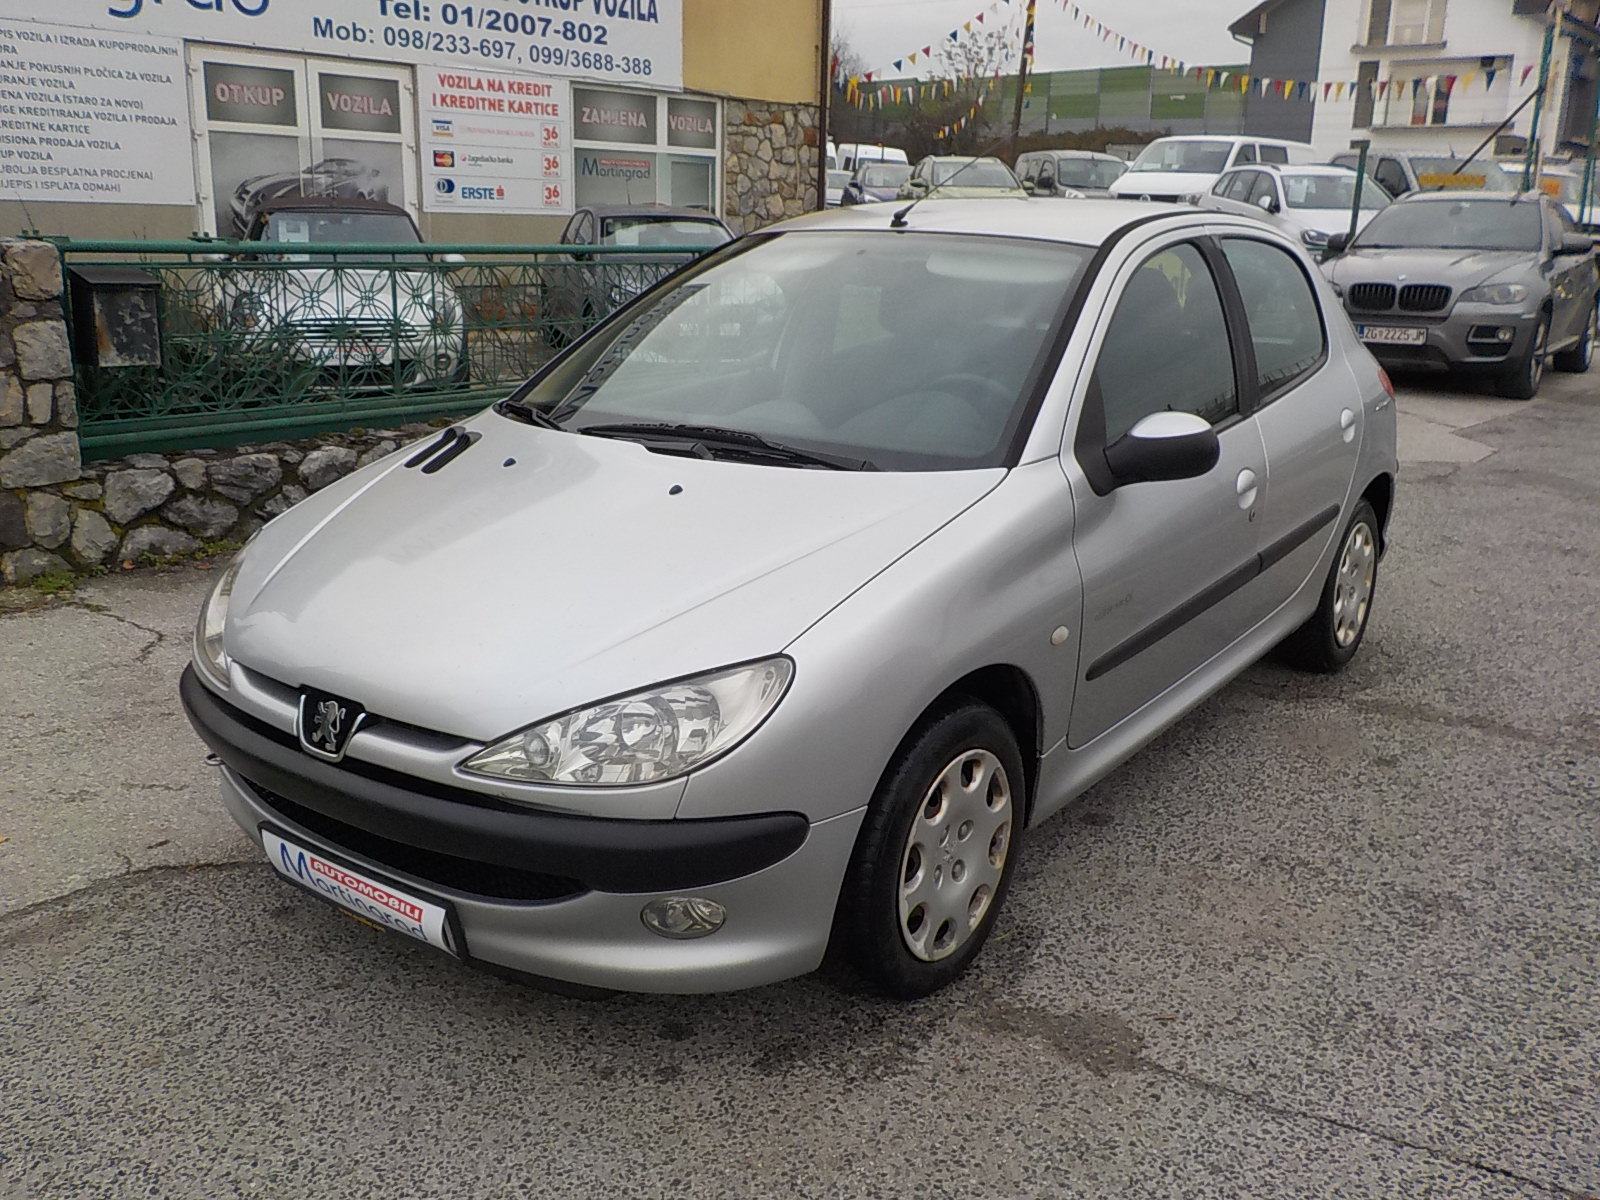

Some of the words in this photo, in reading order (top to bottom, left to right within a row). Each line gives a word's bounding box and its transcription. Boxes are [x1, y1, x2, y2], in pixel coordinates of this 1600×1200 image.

[379, 0, 430, 22] Tel:
[441, 3, 608, 46] 01/2007-802
[16, 31, 52, 43] VOZILA
[60, 35, 96, 47] IZRADA
[99, 40, 178, 56] KUPOPRODAJNIH
[313, 16, 374, 43] Mob:
[384, 26, 522, 65] 098/233-697,
[529, 45, 652, 76] 099/3688-388
[29, 61, 81, 75] POKUSNIH
[125, 71, 138, 80] ZA
[139, 72, 172, 84] VOZILA
[40, 77, 75, 89] VOZILA
[438, 73, 484, 92] VOZILA
[487, 79, 505, 93] NA
[508, 80, 553, 97] KREDIT
[25, 91, 61, 103] VOZILA
[63, 94, 98, 106] (STARO
[100, 97, 112, 107] ZA
[114, 98, 143, 110] NOVO)
[214, 82, 285, 106] OTKUP
[326, 92, 392, 116] VOZILA
[432, 93, 437, 106] I
[440, 93, 505, 112] KREDITNE
[508, 99, 559, 116] KARTICE
[19, 106, 92, 119] KREDITIRANJA
[94, 111, 128, 122] VOZILA
[135, 115, 178, 126] PRODAJA
[581, 106, 647, 128] ZAMJENA
[668, 113, 713, 134] VOZILA
[48, 123, 90, 134] KARTICE
[543, 126, 559, 141] 36
[39, 137, 85, 148] PRODAJA
[87, 140, 121, 151] VOZILA
[17, 150, 53, 160] VOZILA
[544, 156, 559, 171] 36
[40, 166, 98, 178] BESPLATNA
[41, 181, 80, 191] ISPLATA
[461, 187, 495, 200] ERSTE
[545, 185, 560, 200] 36
[1365, 328, 1378, 339] ZG
[280, 843, 429, 941] Martingrad
[313, 861, 420, 921] AUTOMOBILI
